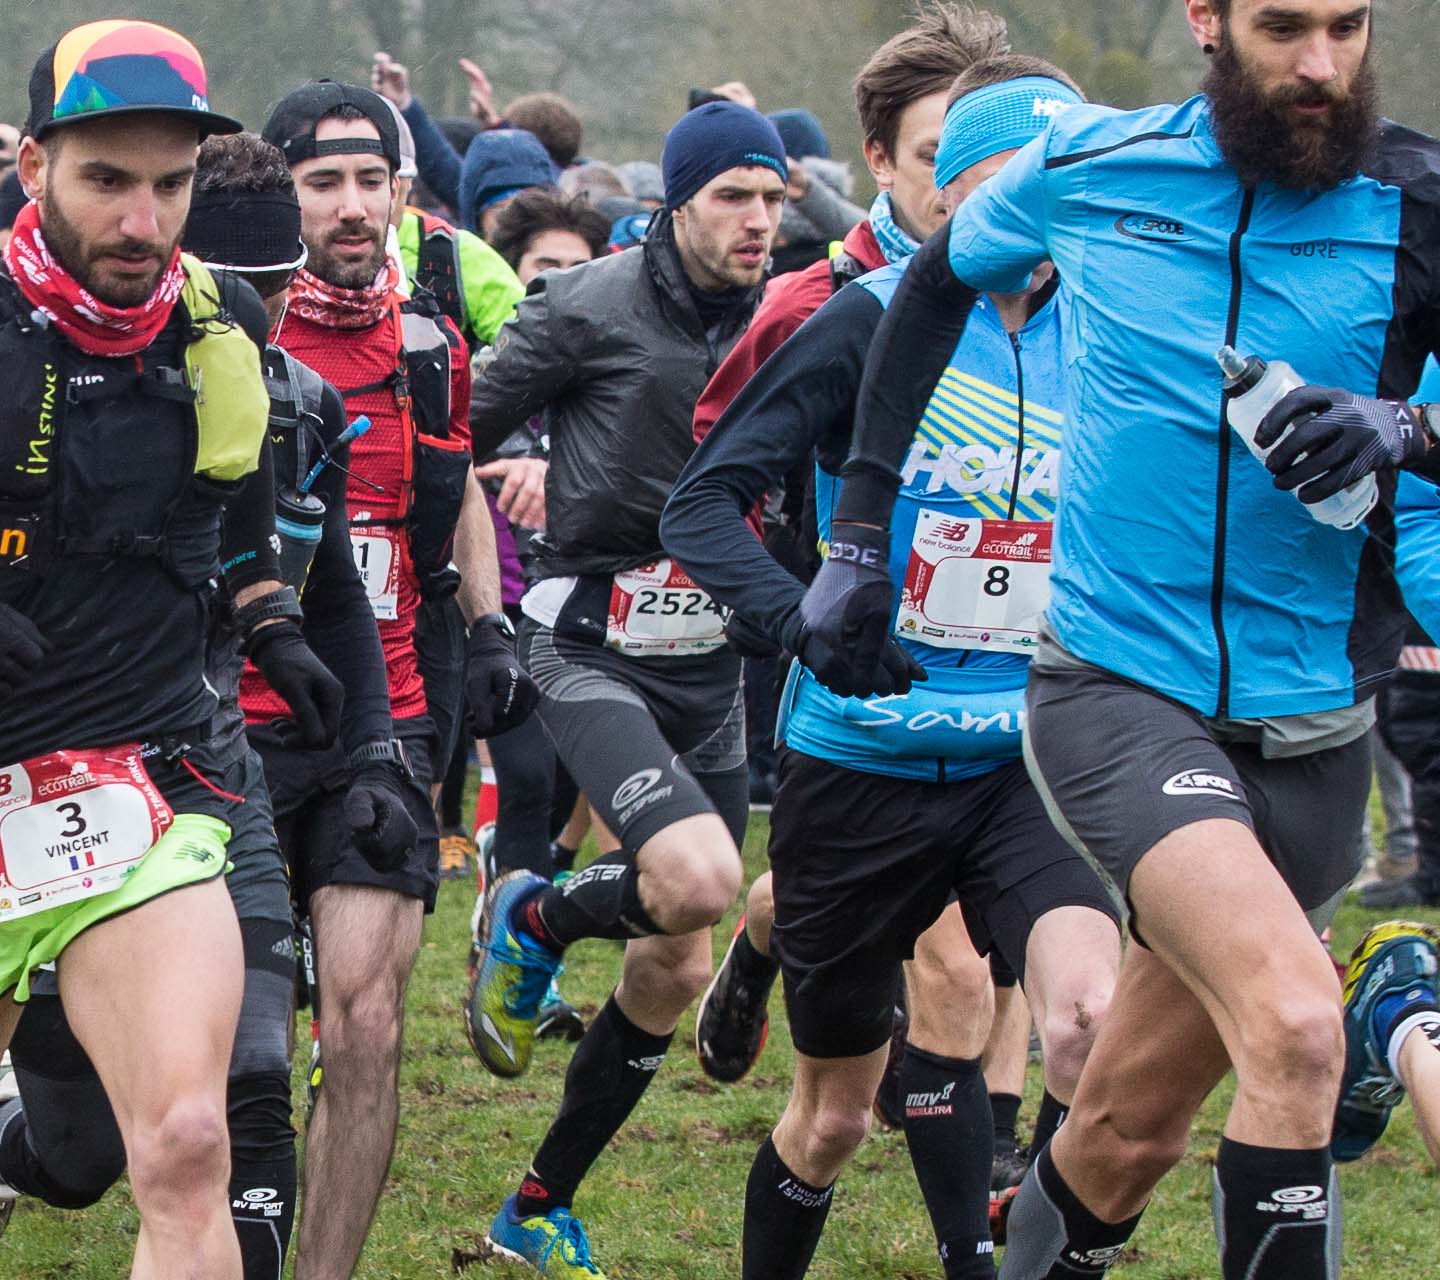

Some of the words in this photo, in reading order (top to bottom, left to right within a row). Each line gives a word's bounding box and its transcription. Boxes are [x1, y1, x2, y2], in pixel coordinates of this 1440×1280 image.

[983, 566, 1010, 596] 8
[55, 802, 87, 838] 3
[45, 830, 110, 859] VINCENT
[249, 1201, 284, 1210] SPORT
